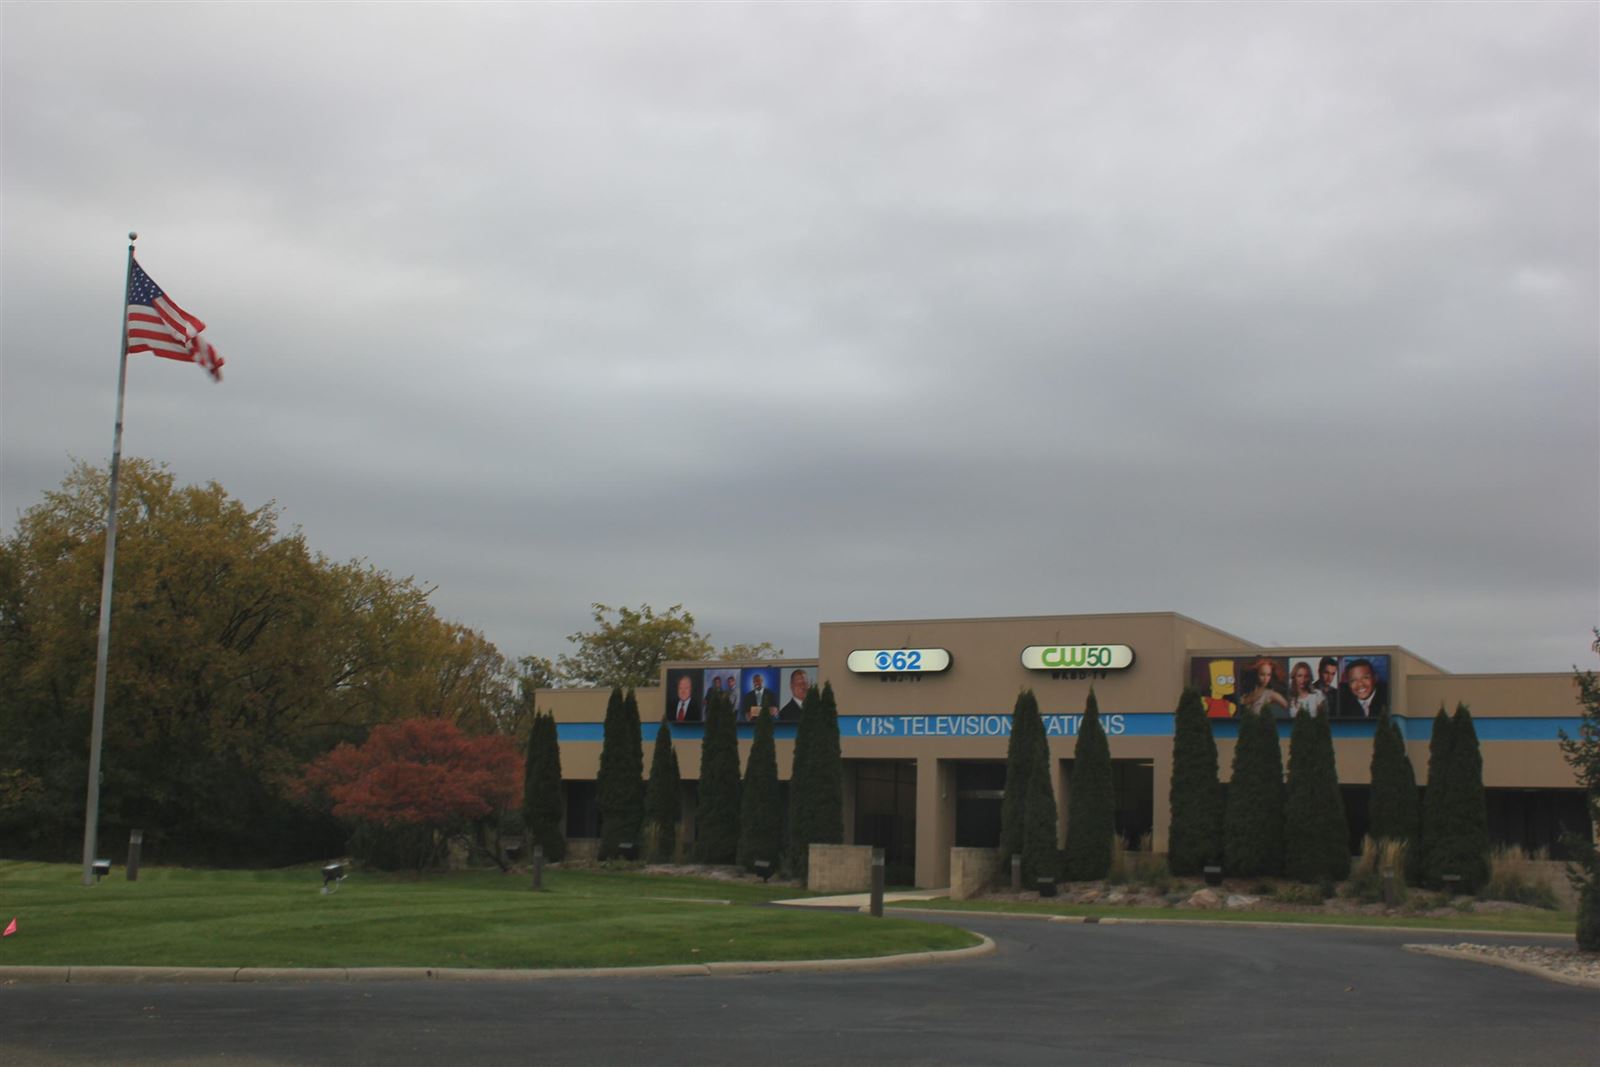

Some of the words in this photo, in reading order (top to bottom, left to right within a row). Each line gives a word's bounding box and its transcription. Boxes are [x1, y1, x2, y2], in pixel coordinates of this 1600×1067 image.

[892, 651, 921, 670] 62
[1051, 670, 1107, 680] WKBD-TV
[857, 716, 895, 736] CBS
[900, 716, 1012, 735] TELEVISION
[1040, 715, 1125, 734] ATINS
